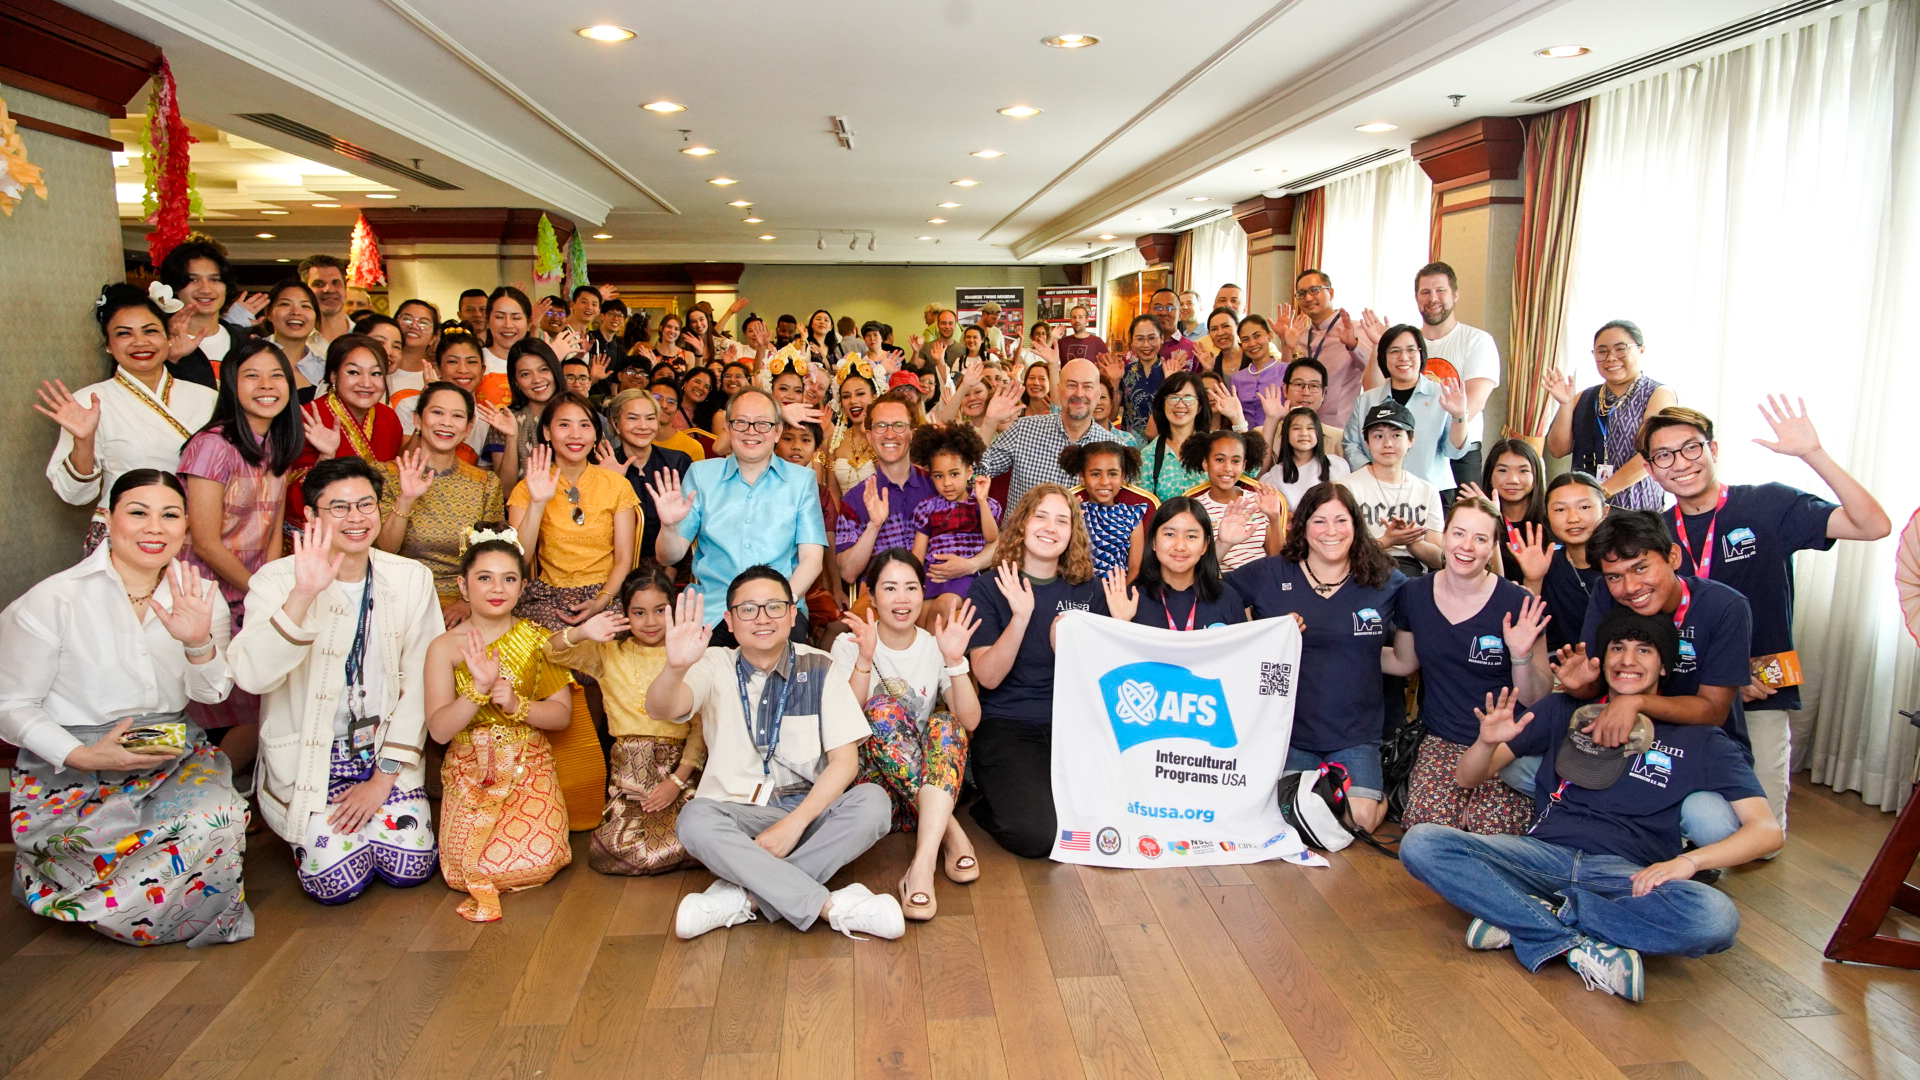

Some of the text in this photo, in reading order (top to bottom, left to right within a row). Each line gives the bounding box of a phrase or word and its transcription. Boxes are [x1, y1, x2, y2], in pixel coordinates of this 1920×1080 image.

[1678, 626, 1695, 639] afi
[1764, 667, 1778, 683] AFS
[1770, 660, 1783, 679] USA
[1159, 690, 1216, 726] AFS
[1650, 740, 1684, 758] dam
[1156, 750, 1237, 770] Intercultural
[1155, 766, 1246, 787] Programs USA
[1128, 801, 1215, 822] afsusa.org
